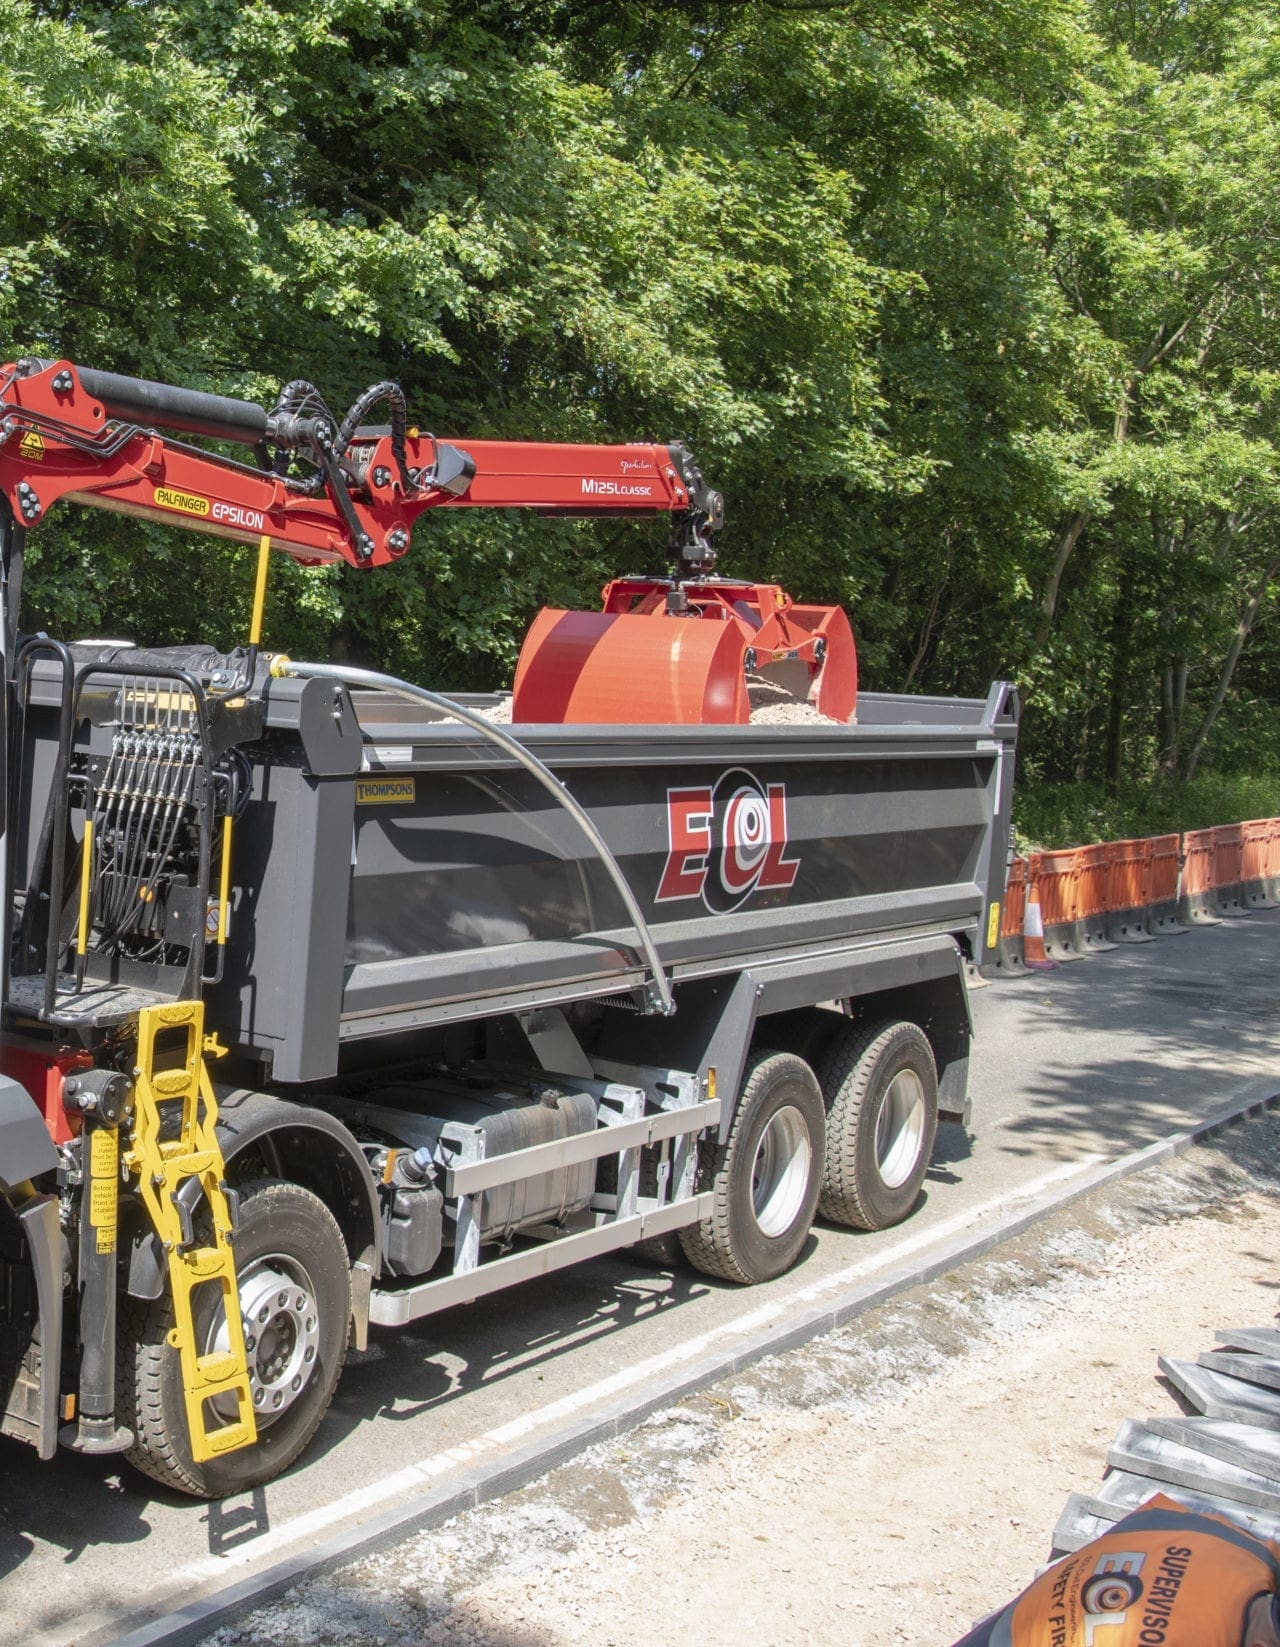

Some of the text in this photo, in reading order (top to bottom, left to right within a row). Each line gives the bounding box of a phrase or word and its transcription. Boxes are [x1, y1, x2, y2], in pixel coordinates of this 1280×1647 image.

[158, 490, 264, 529] PALFINGER EPSILON
[358, 784, 413, 799] THOMPSONS
[1138, 1546, 1192, 1647] SUPERVISO
[1048, 1615, 1066, 1647] FIR
